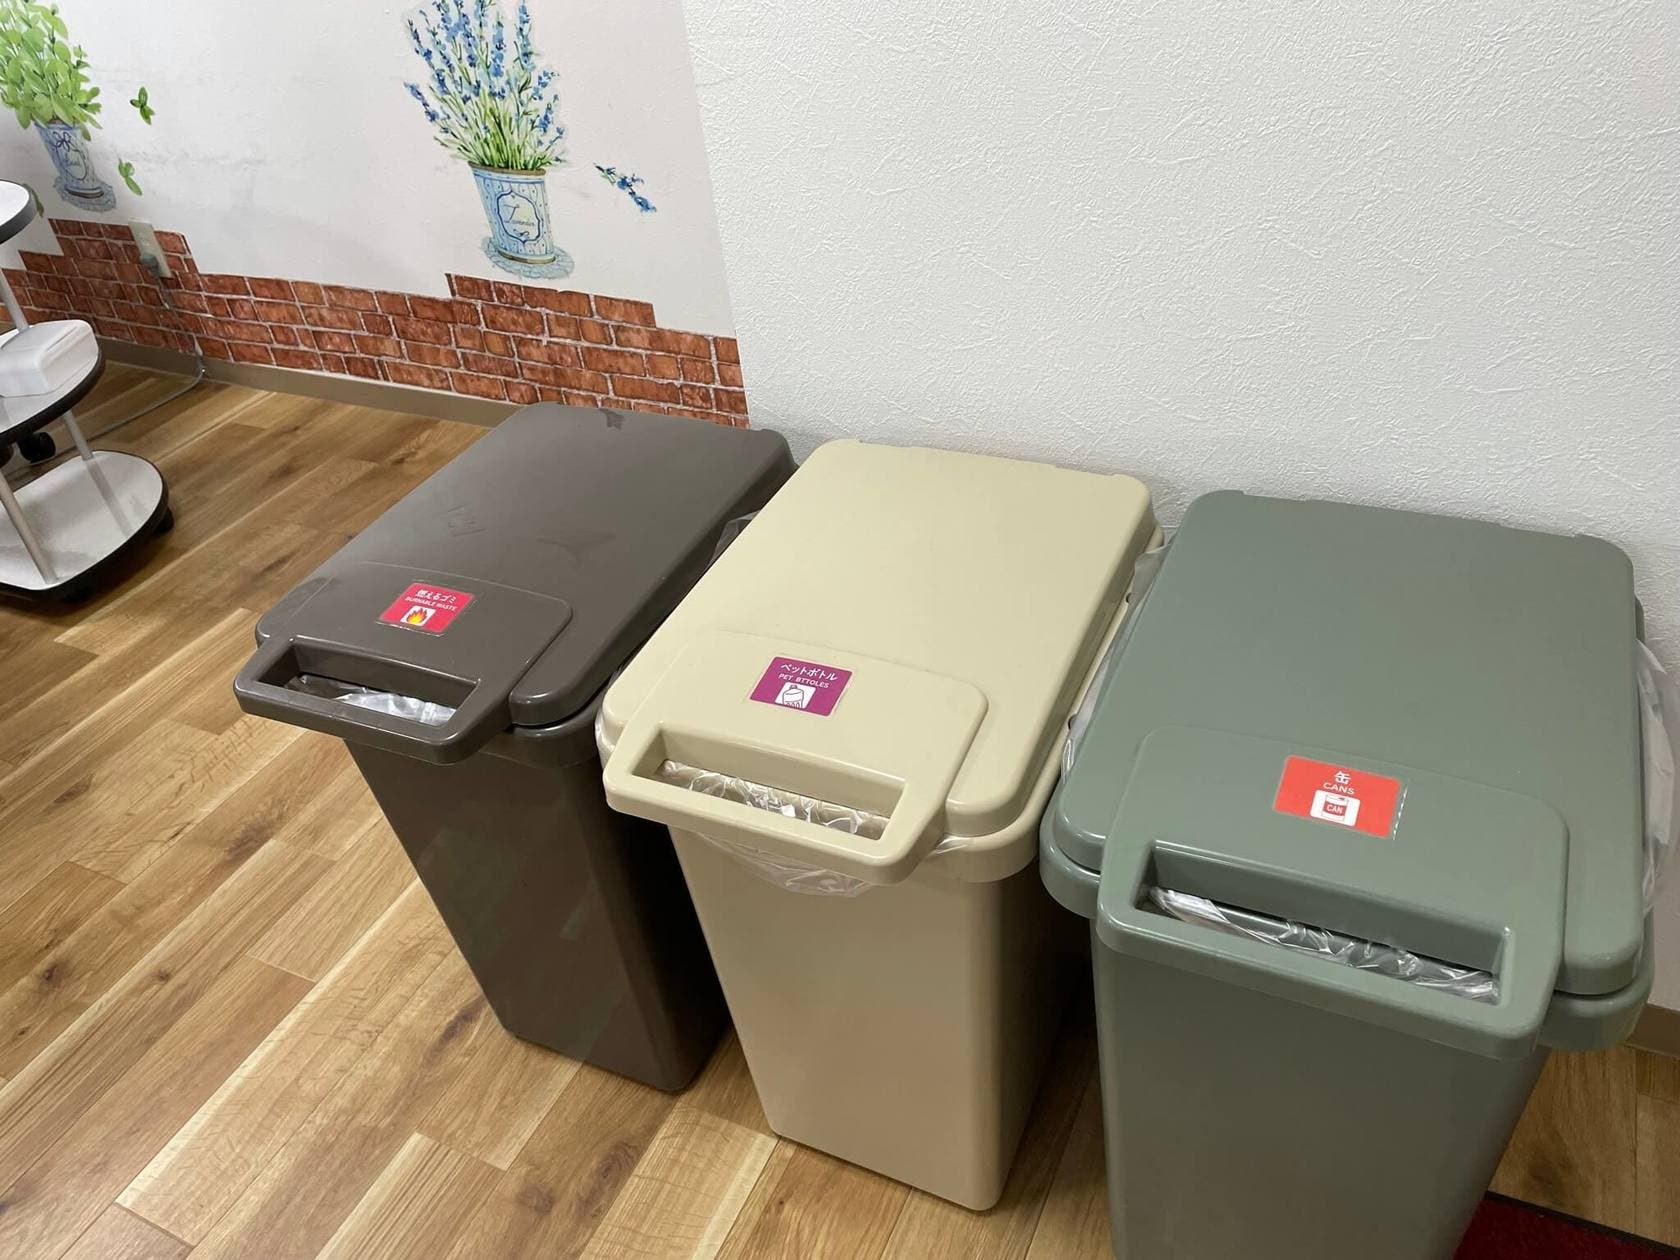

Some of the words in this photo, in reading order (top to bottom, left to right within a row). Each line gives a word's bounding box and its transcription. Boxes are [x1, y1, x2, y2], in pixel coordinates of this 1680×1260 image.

[415, 589, 457, 603] 燃えるゴミ
[778, 673, 794, 681] PET
[780, 663, 838, 681] ペットボトル
[1334, 770, 1352, 785] 缶
[1323, 782, 1355, 795] CANS
[1326, 804, 1343, 814] CAN
